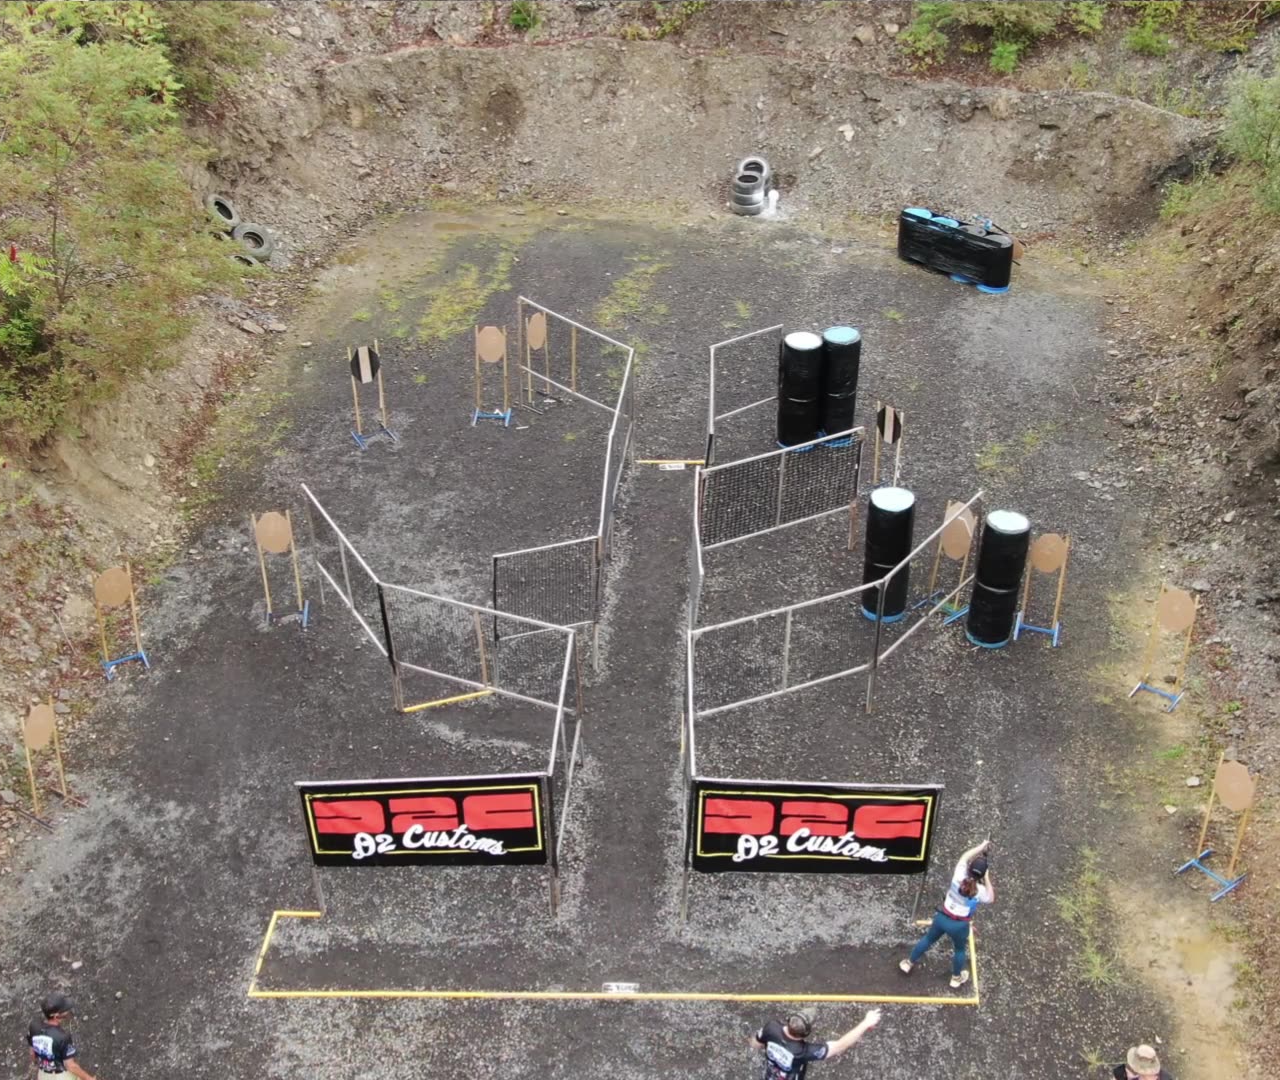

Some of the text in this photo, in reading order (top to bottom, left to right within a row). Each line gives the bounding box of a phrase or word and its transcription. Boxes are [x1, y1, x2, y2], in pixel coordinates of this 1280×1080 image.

[352, 824, 507, 859] D2 Customs
[732, 827, 888, 862] D2 Customs
